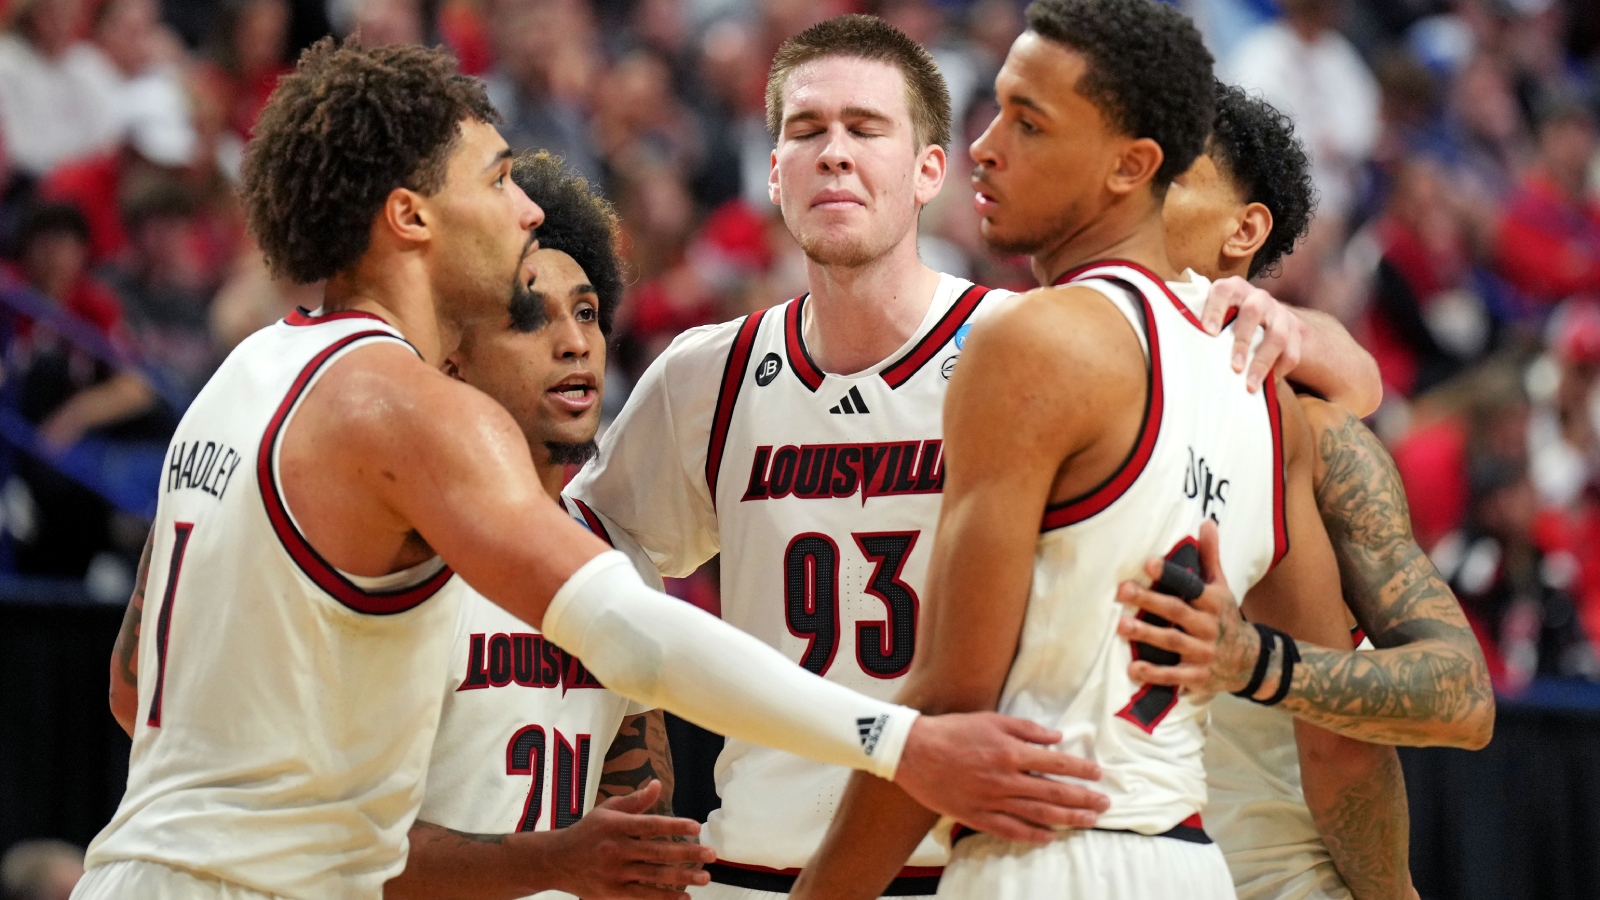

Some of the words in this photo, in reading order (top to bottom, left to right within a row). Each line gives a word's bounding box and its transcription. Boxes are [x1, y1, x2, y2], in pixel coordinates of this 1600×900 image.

[759, 360, 778, 379] JB
[167, 440, 241, 501] HADLEY
[740, 439, 944, 508] LOUISVILL
[146, 520, 195, 728] 1
[784, 530, 921, 680] 93
